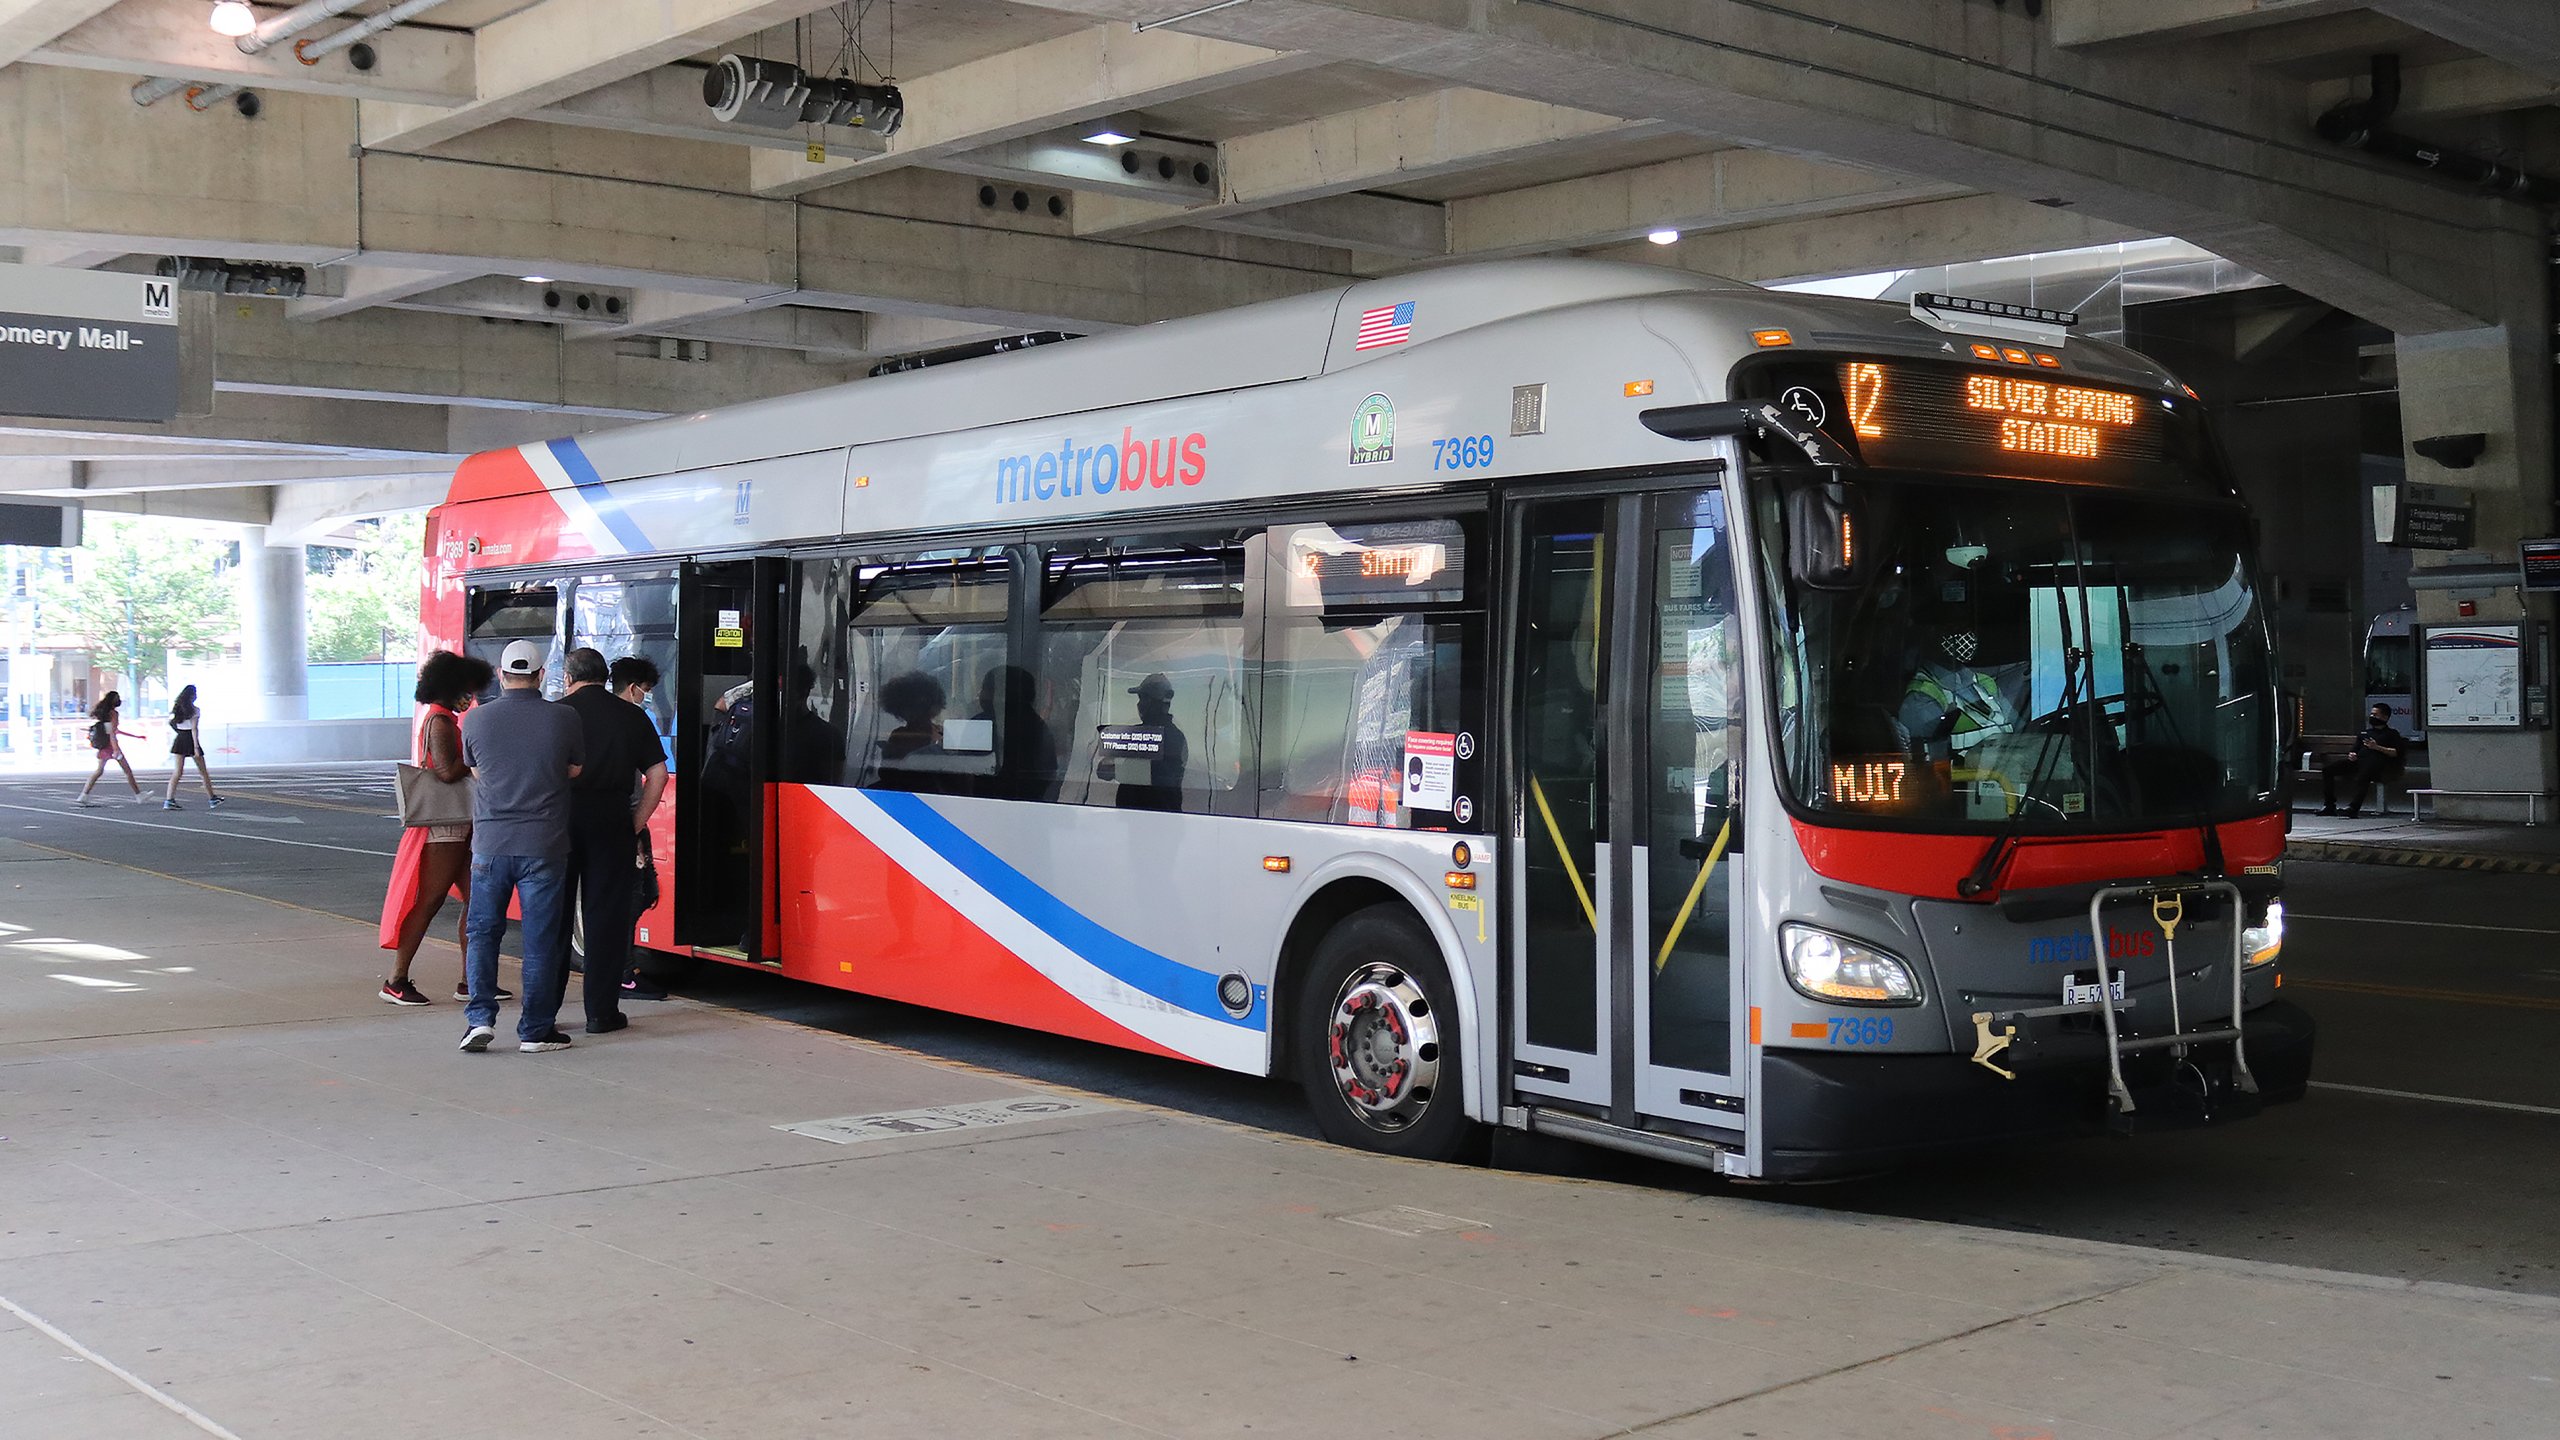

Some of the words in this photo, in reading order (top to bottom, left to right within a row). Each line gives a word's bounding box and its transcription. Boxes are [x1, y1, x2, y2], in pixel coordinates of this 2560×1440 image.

[146, 283, 169, 308] M
[1967, 376, 2049, 415] SILVER
[2054, 387, 2134, 425] SPRING
[1365, 413, 1381, 436] M
[2001, 419, 2098, 457] STATION
[996, 426, 1207, 504] metrobus
[1353, 450, 1390, 464] HYBRID
[1432, 435, 1495, 470] 7369
[445, 541, 464, 558] 7369
[1361, 549, 1433, 576] STATION
[1834, 762, 1906, 803] MJ17
[1451, 893, 1477, 902] KNEELING
[1457, 902, 1469, 910] BUS
[1828, 1016, 1894, 1046] 7369
